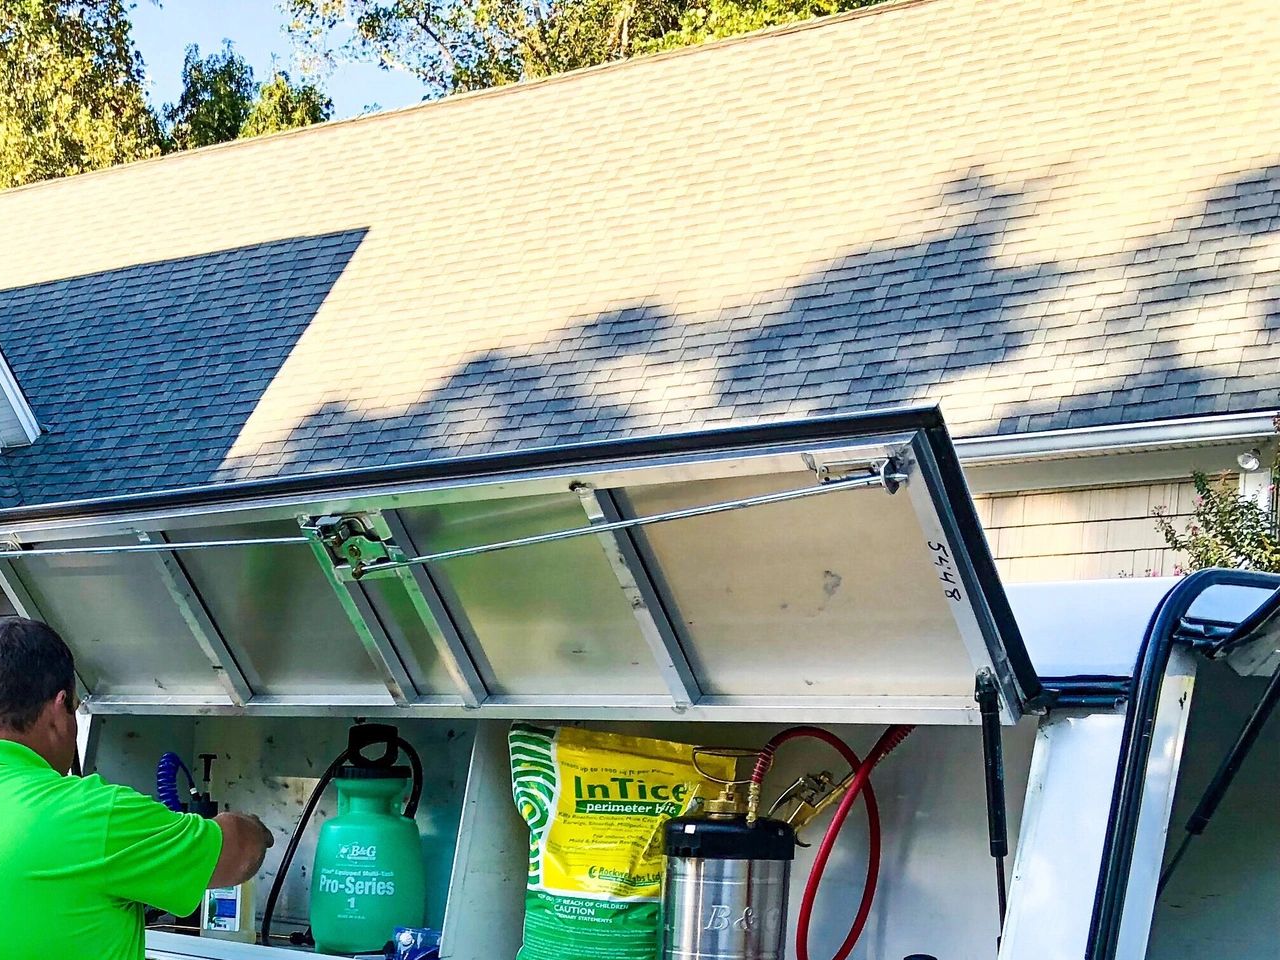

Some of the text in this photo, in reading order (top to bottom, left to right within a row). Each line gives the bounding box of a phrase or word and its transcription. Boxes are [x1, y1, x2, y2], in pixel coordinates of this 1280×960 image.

[574, 776, 688, 802] InTice
[586, 802, 651, 814] perimeter
[351, 845, 377, 857] B&G
[319, 874, 395, 896] Pro-Series
[347, 897, 356, 909] 1
[554, 904, 595, 916] CAUTION
